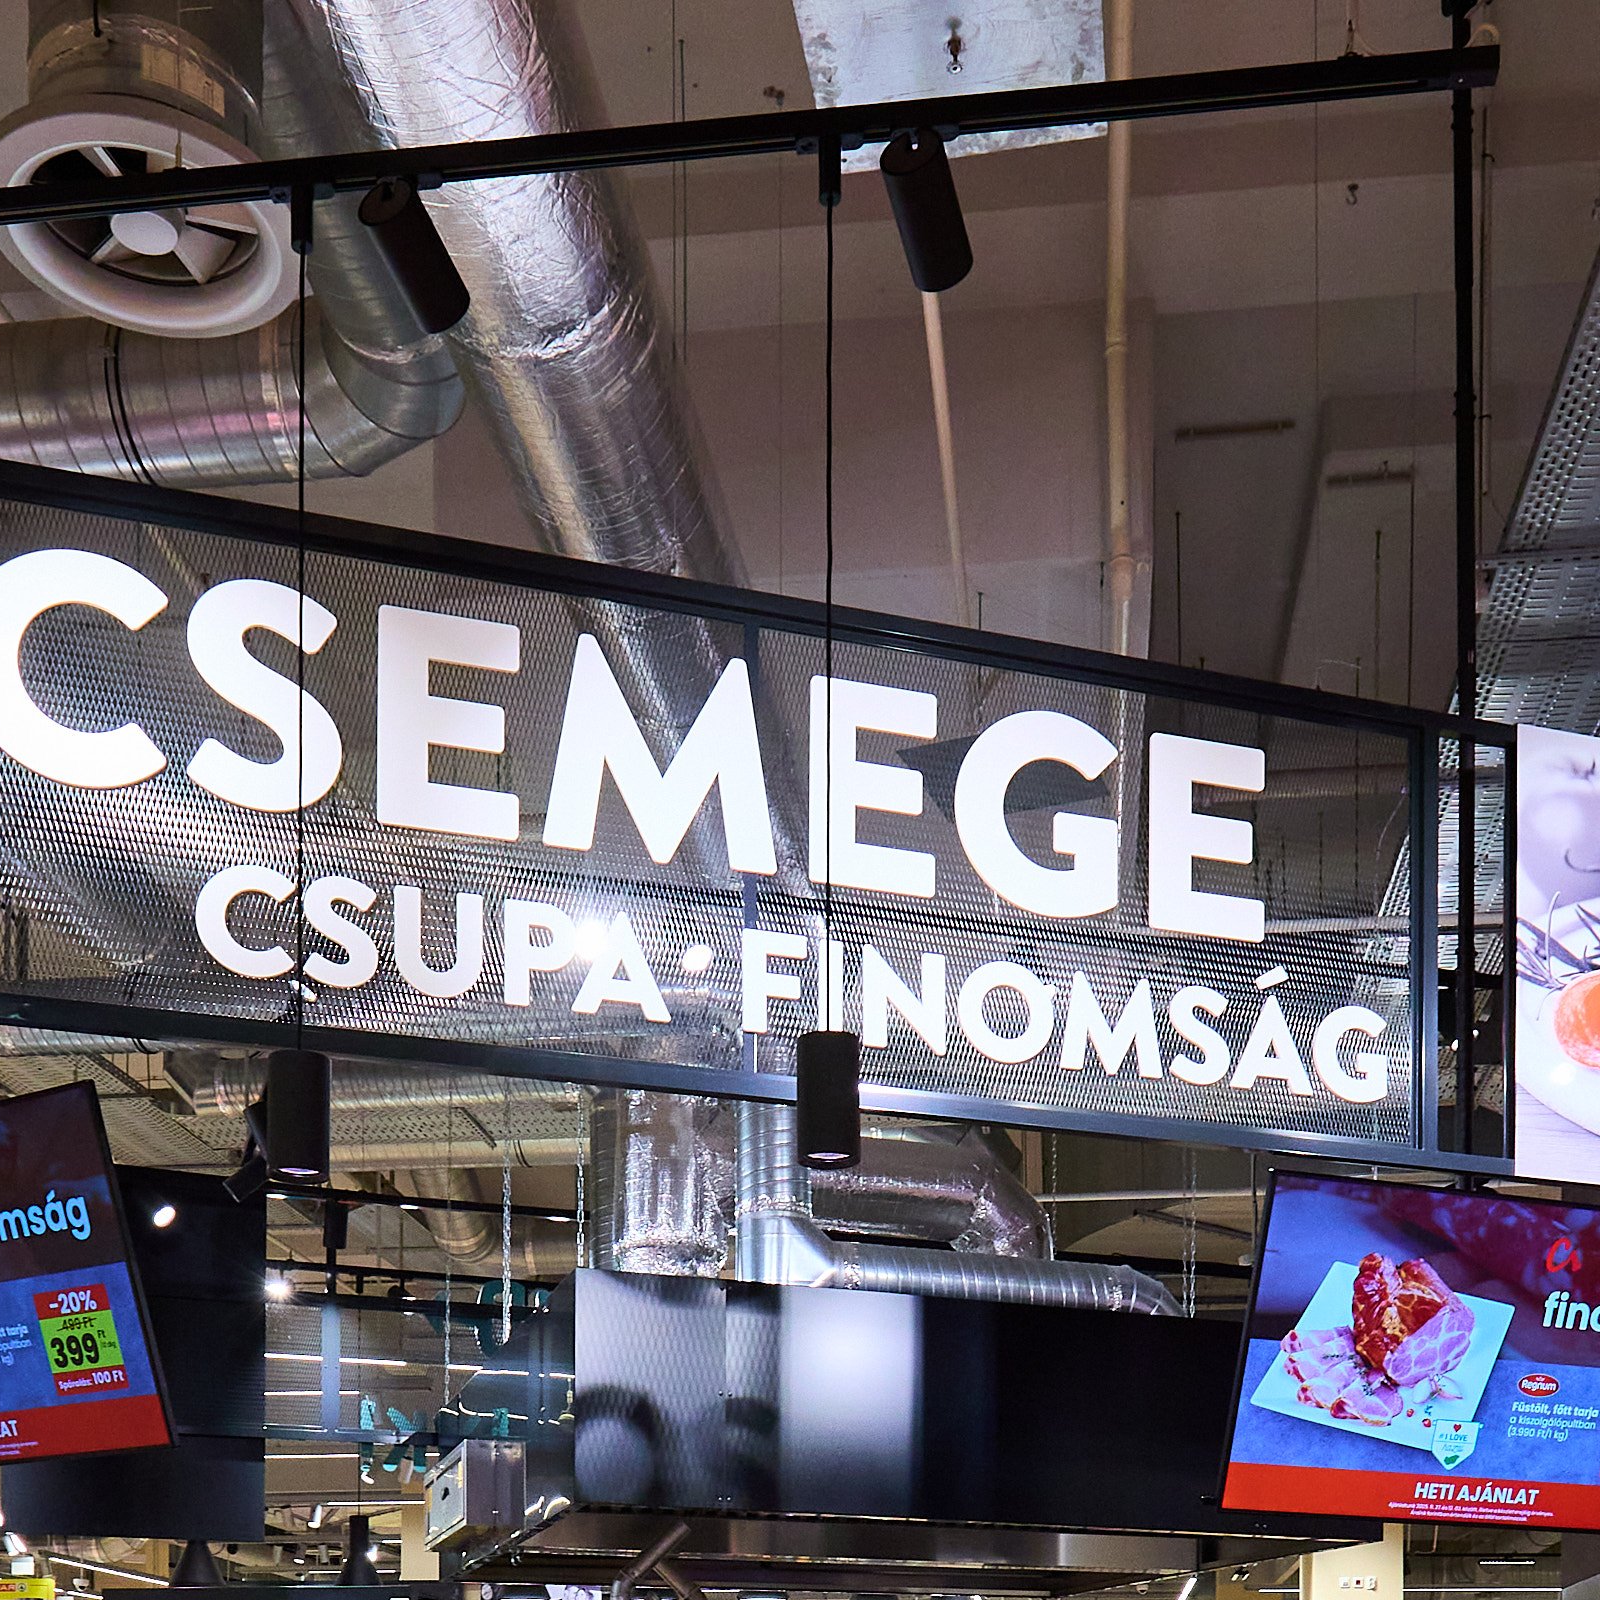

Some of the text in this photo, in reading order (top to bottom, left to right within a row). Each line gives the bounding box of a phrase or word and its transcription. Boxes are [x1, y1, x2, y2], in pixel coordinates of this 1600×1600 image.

[195, 863, 1389, 1106] CSUPA FINOMSÁG
[49, 1289, 98, 1315] -20%
[51, 1333, 100, 1369] 399
[93, 1373, 111, 1385] 100
[111, 1371, 125, 1383] Ft
[1521, 1379, 1557, 1392] Regnum
[1415, 1482, 1539, 1506] HETI AJÁNLAT
